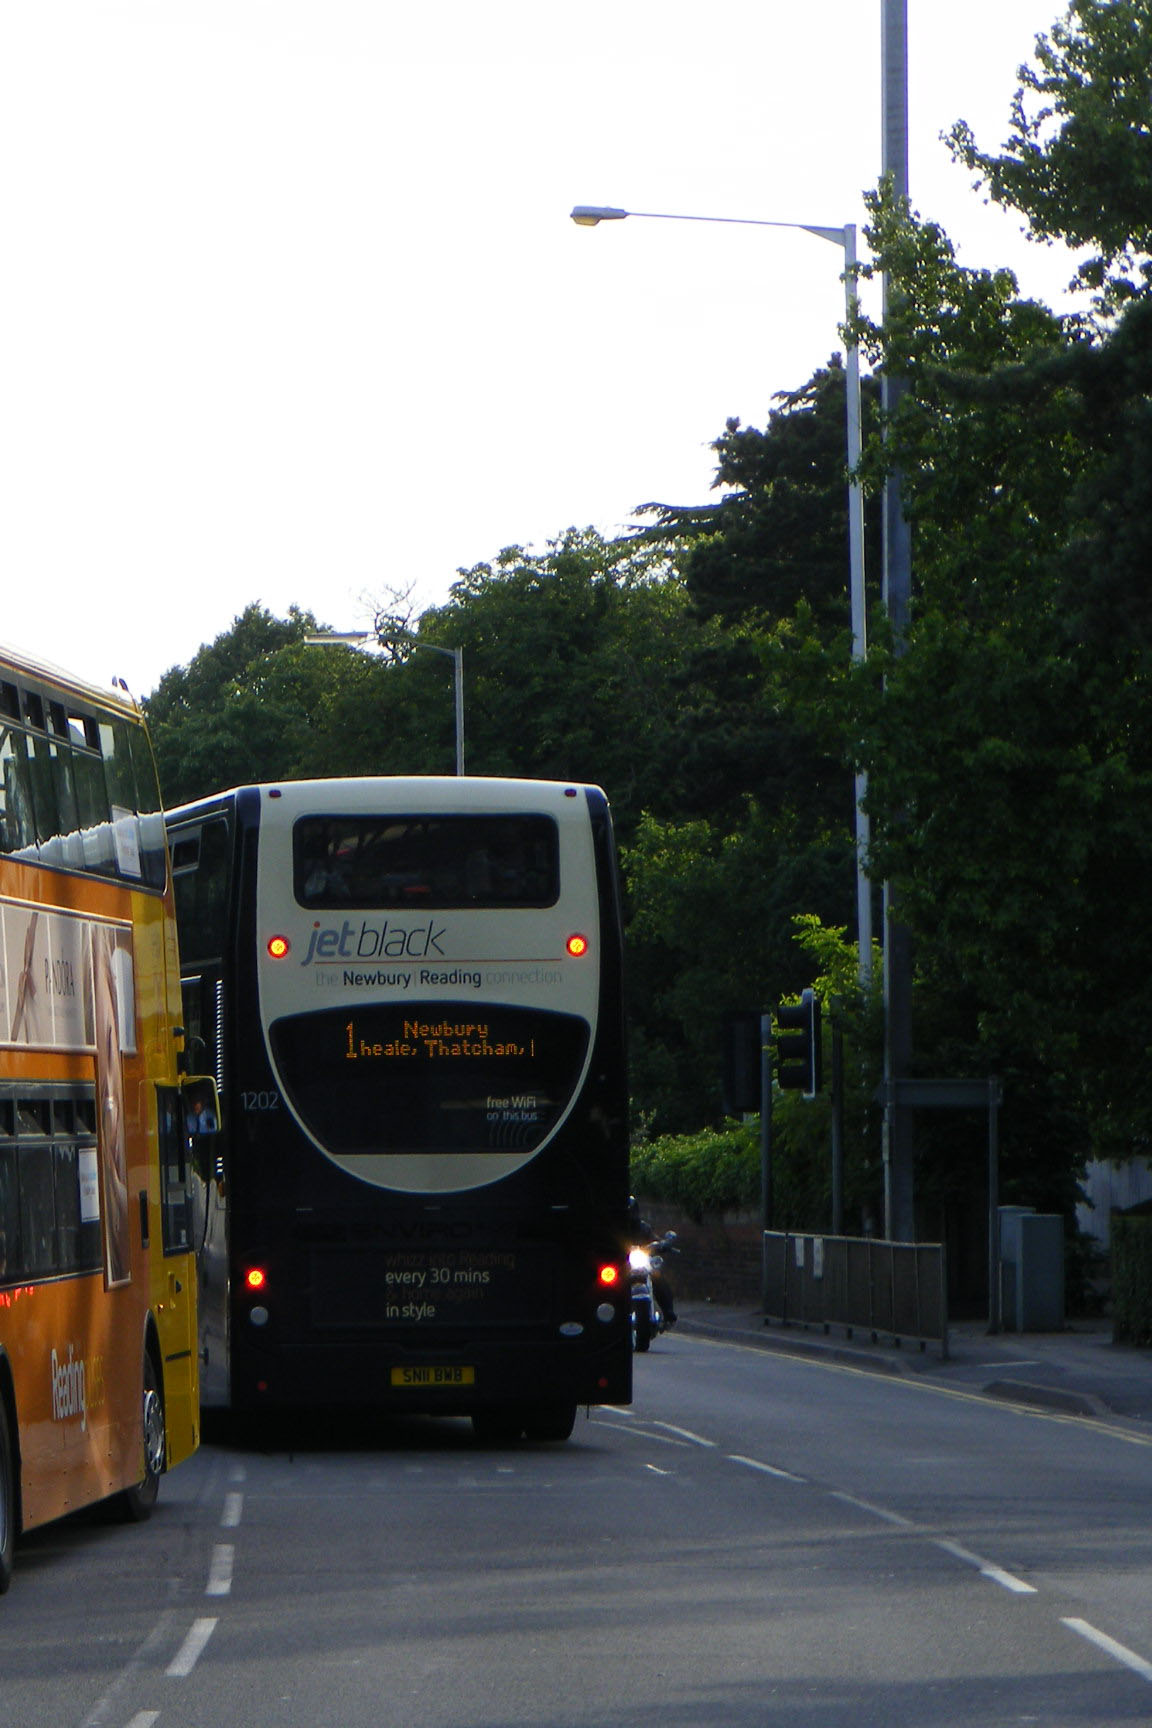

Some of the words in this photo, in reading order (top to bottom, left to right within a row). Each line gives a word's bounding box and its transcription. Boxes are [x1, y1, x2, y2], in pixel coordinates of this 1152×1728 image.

[343, 970, 412, 989] Newbury
[420, 968, 482, 988] Reading
[485, 968, 563, 985] connection
[345, 1020, 358, 1059] 1
[401, 1019, 490, 1039] Newbury
[240, 1090, 280, 1110] 1202
[486, 1095, 510, 1109] free
[384, 1271, 427, 1288] every
[429, 1268, 450, 1284] 30
[453, 1268, 491, 1284] mins
[385, 1302, 399, 1318] in
[401, 1301, 436, 1321] style
[51, 1345, 87, 1433] Reading
